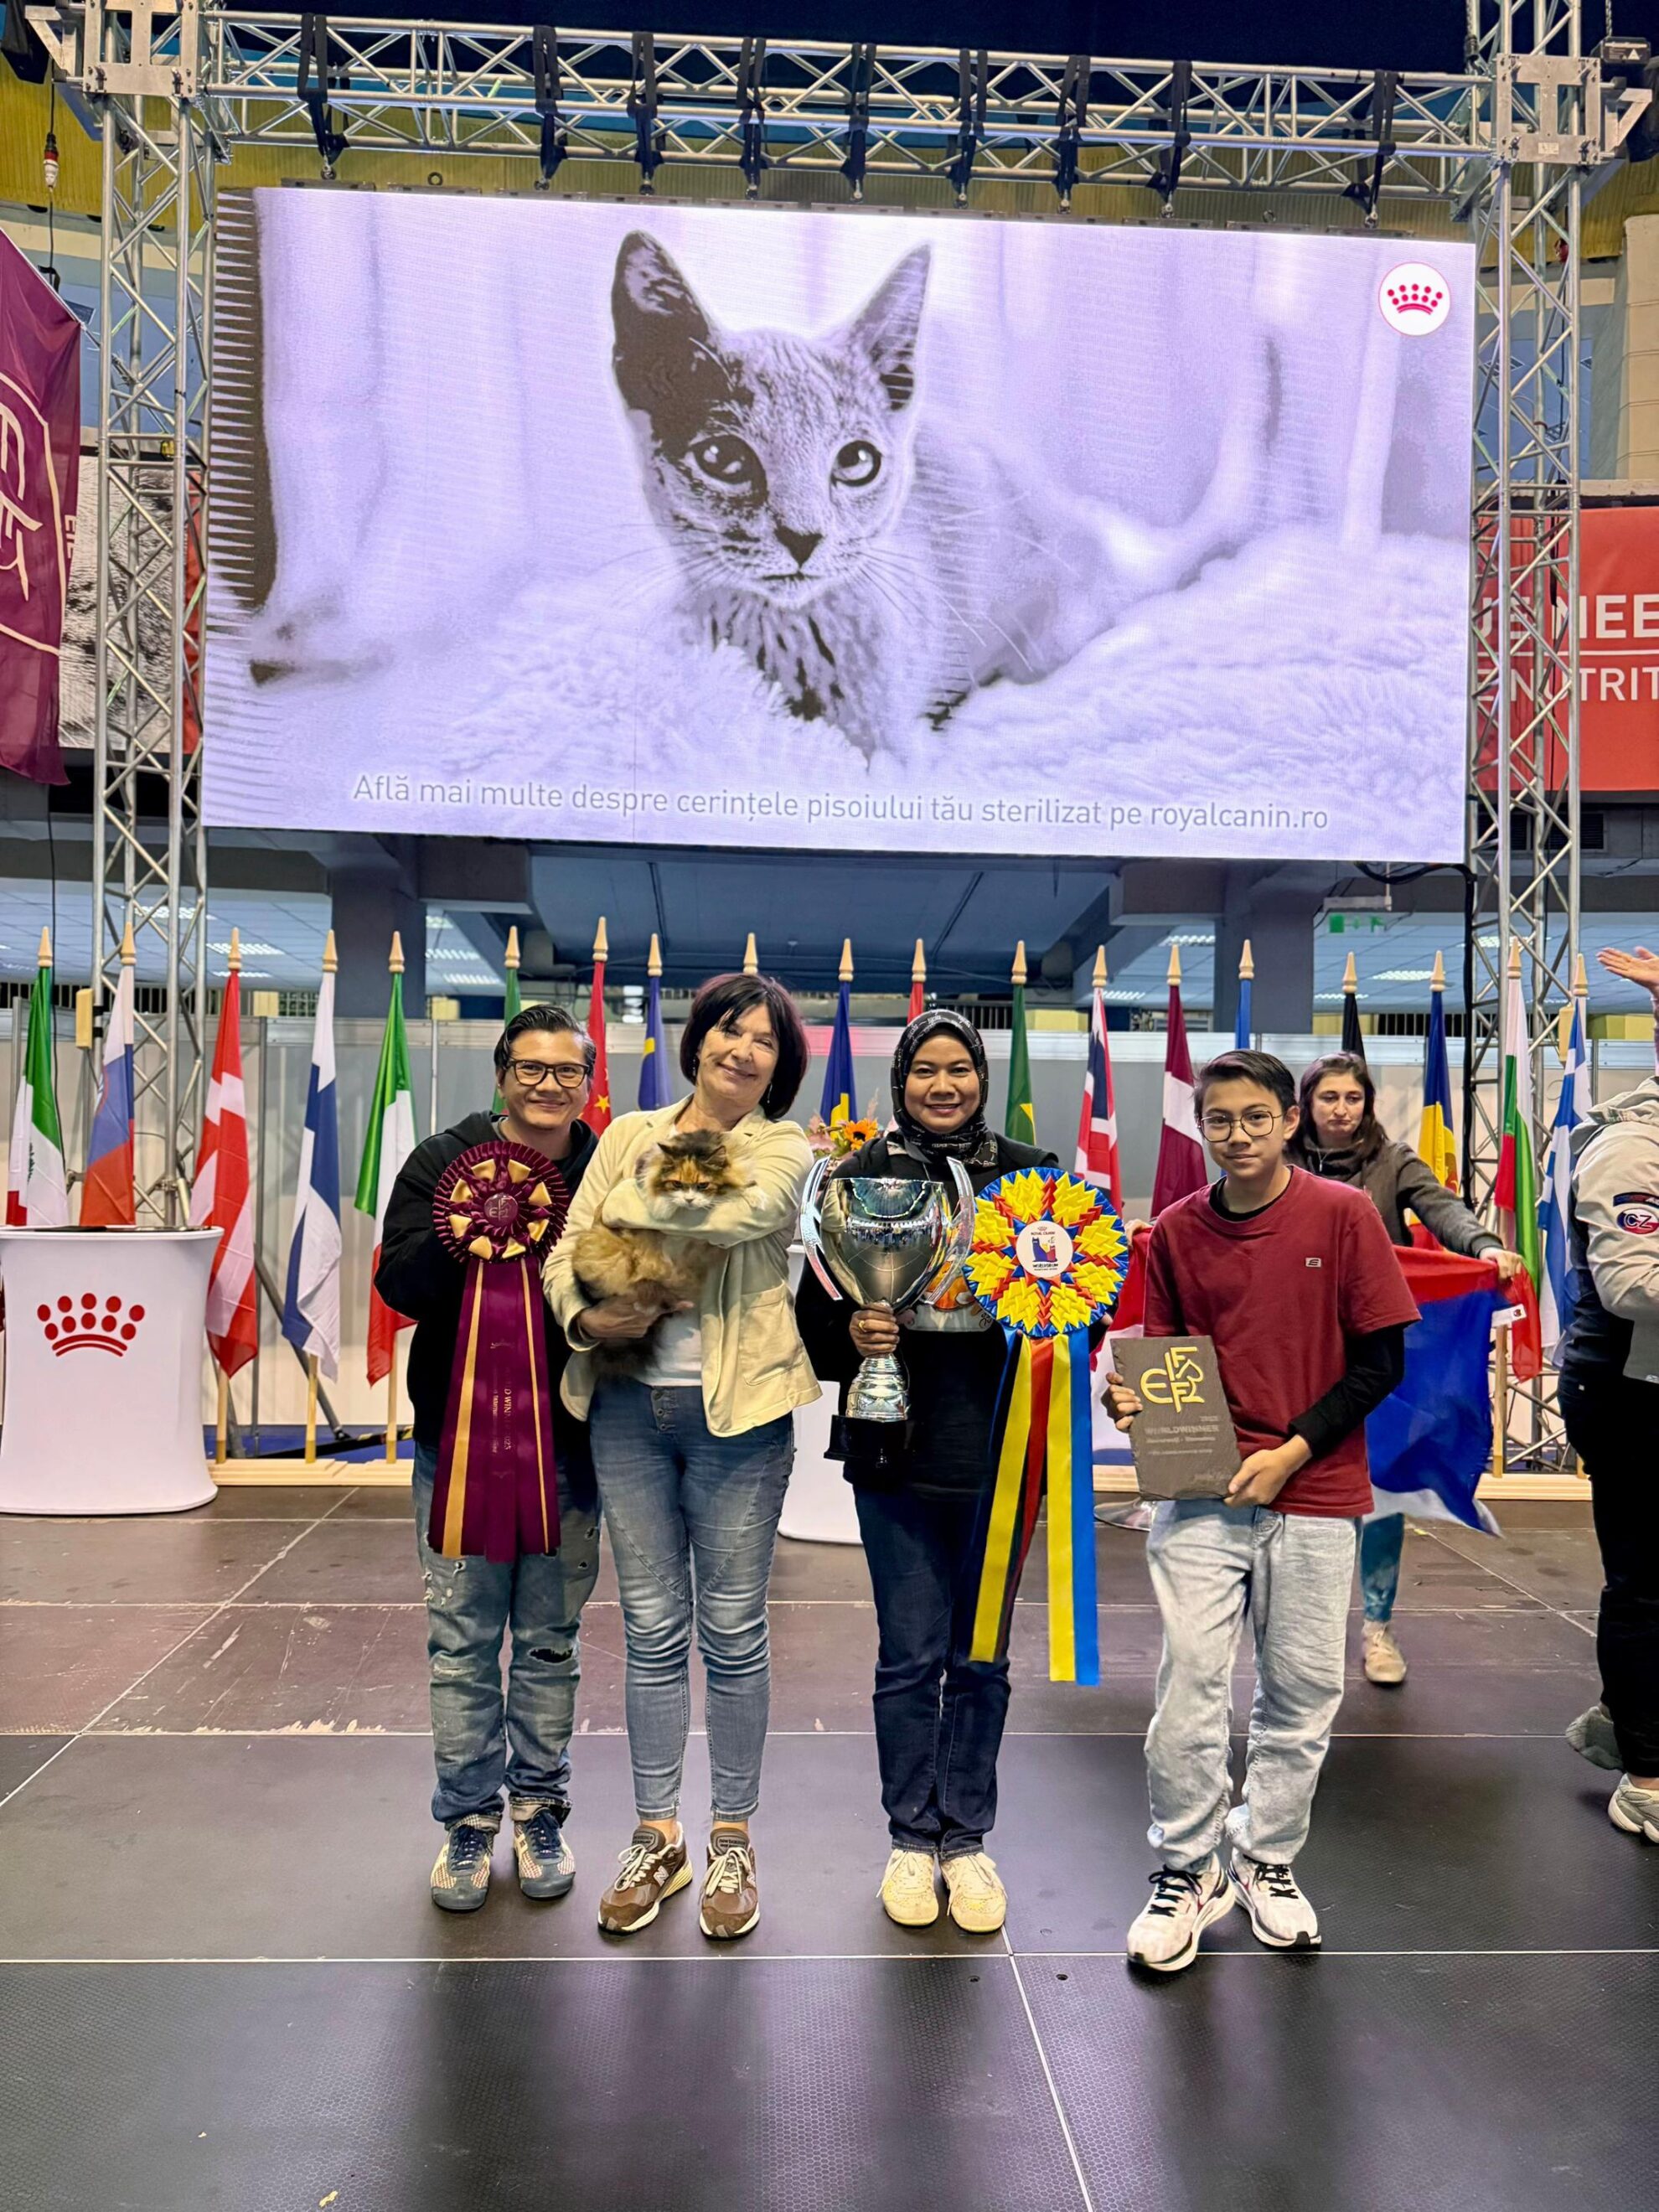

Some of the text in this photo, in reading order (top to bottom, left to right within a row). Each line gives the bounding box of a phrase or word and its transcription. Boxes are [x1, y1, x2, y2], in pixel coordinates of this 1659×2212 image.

[353, 774, 1329, 832] Află mai multe despre cerințele pisoiului tău sterilizat pe royalcanin.ro
[1625, 1213, 1652, 1229] CZ
